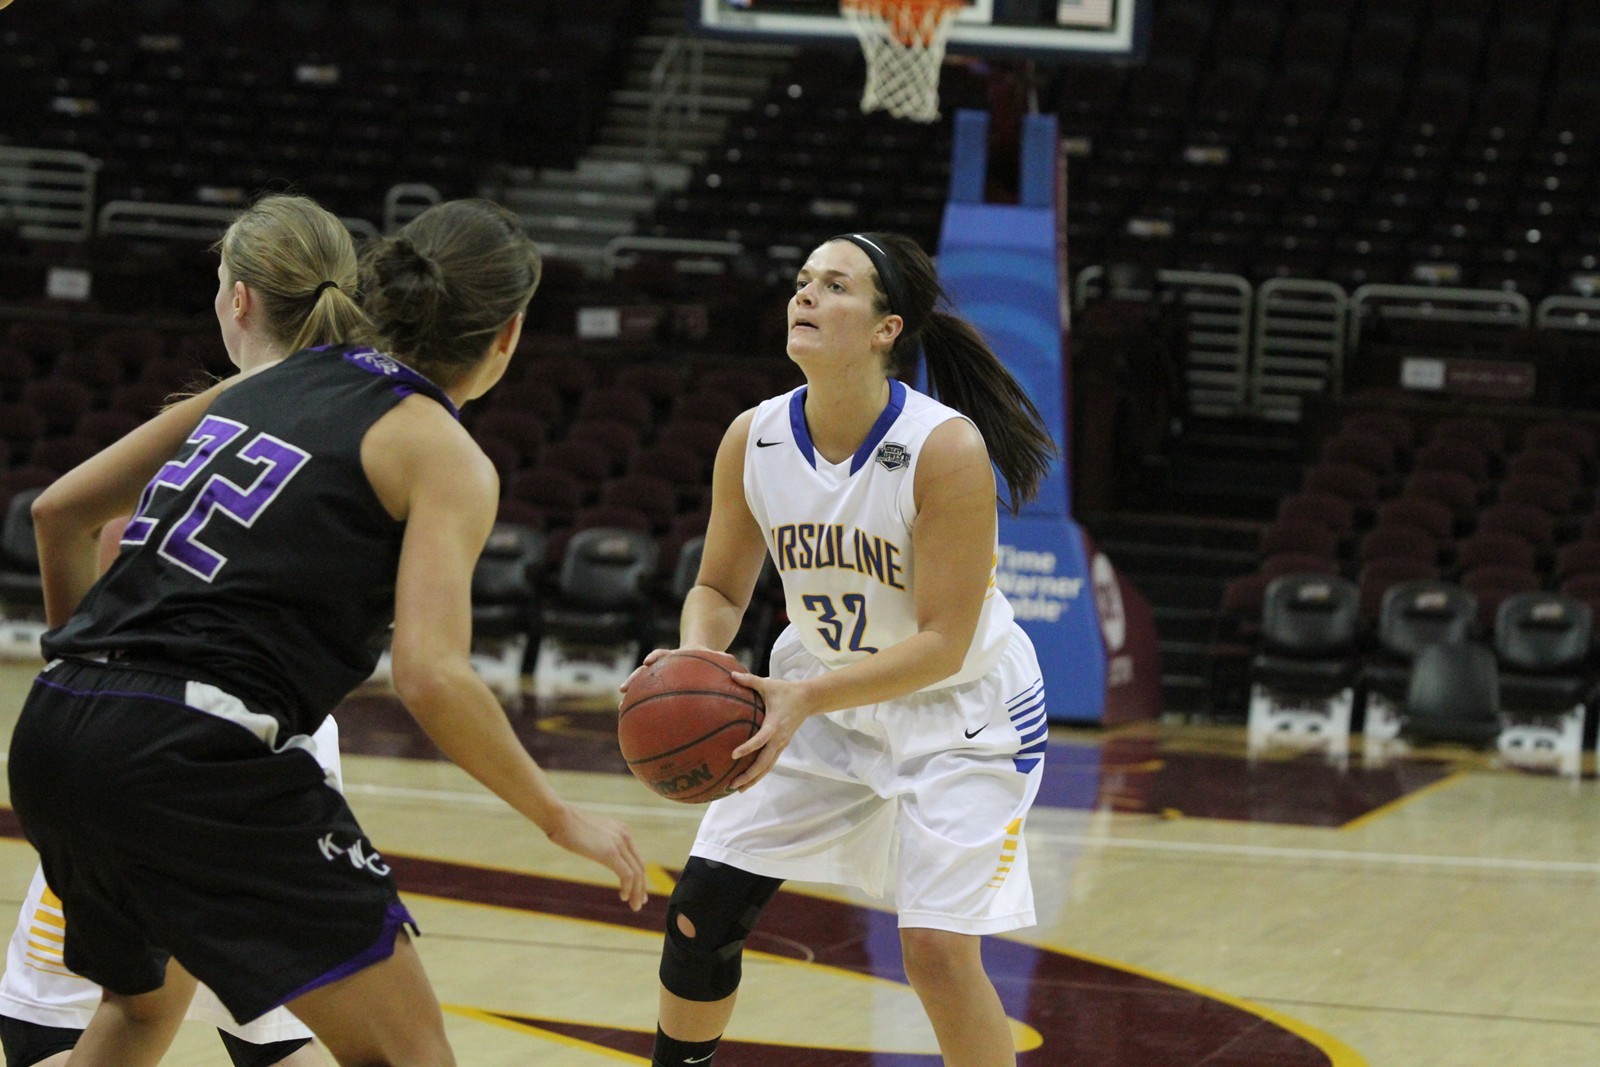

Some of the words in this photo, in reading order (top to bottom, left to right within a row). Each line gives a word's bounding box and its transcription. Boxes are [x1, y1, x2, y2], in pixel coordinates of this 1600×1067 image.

[119, 414, 312, 583] 22
[801, 592, 879, 655] 32
[317, 832, 391, 876] KWC
